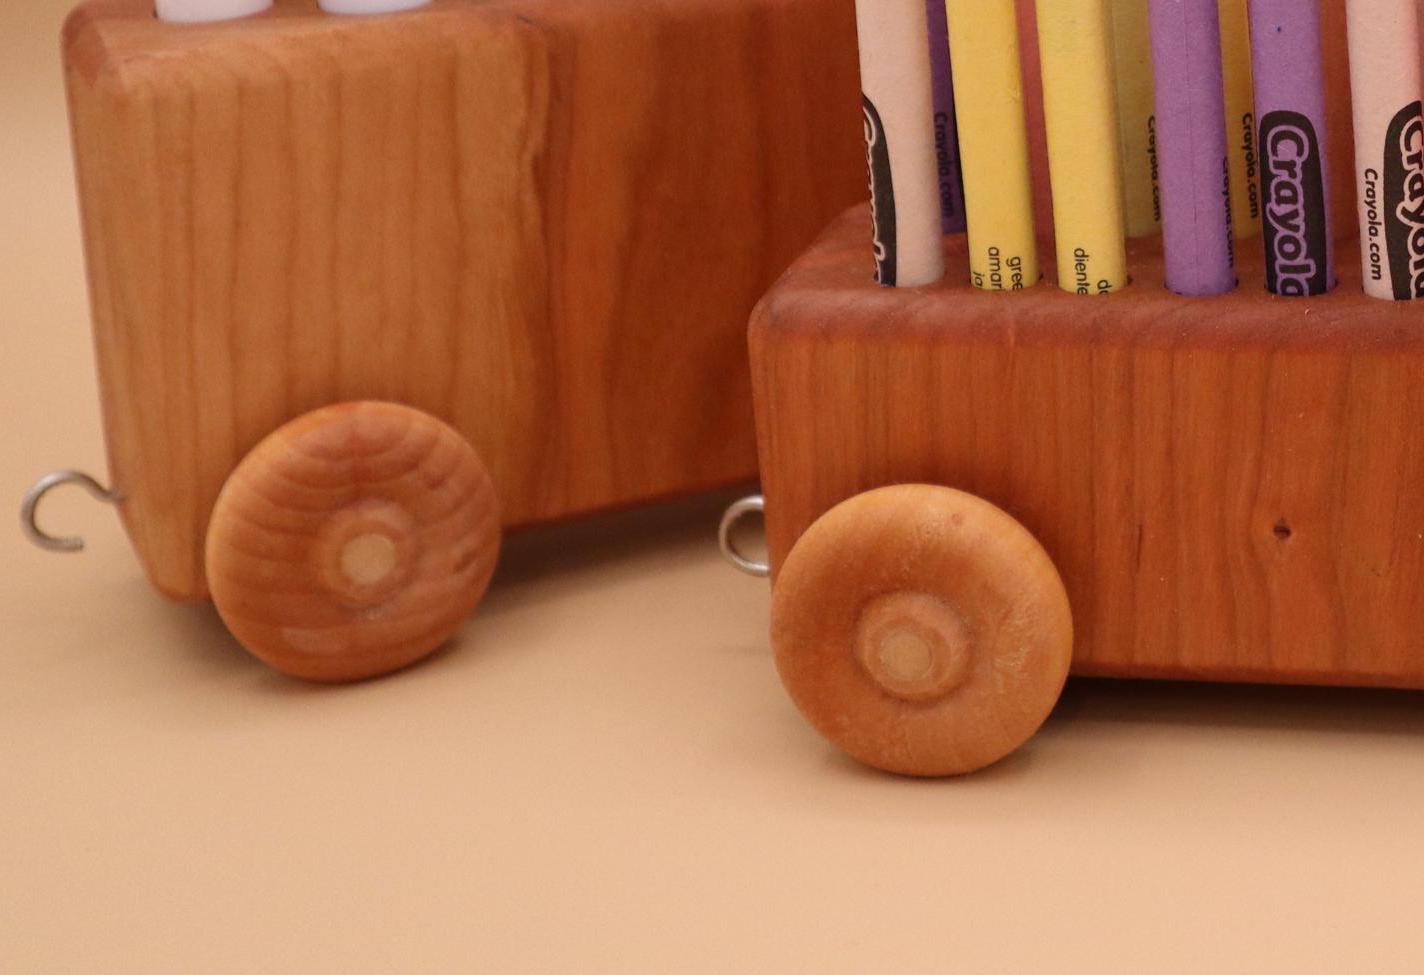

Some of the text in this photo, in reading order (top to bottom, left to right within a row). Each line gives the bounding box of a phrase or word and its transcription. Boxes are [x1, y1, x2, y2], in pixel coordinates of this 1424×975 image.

[1242, 112, 1258, 219] Crayola.com
[1266, 125, 1316, 296] Crayola
[1364, 168, 1382, 281] Crayola.com
